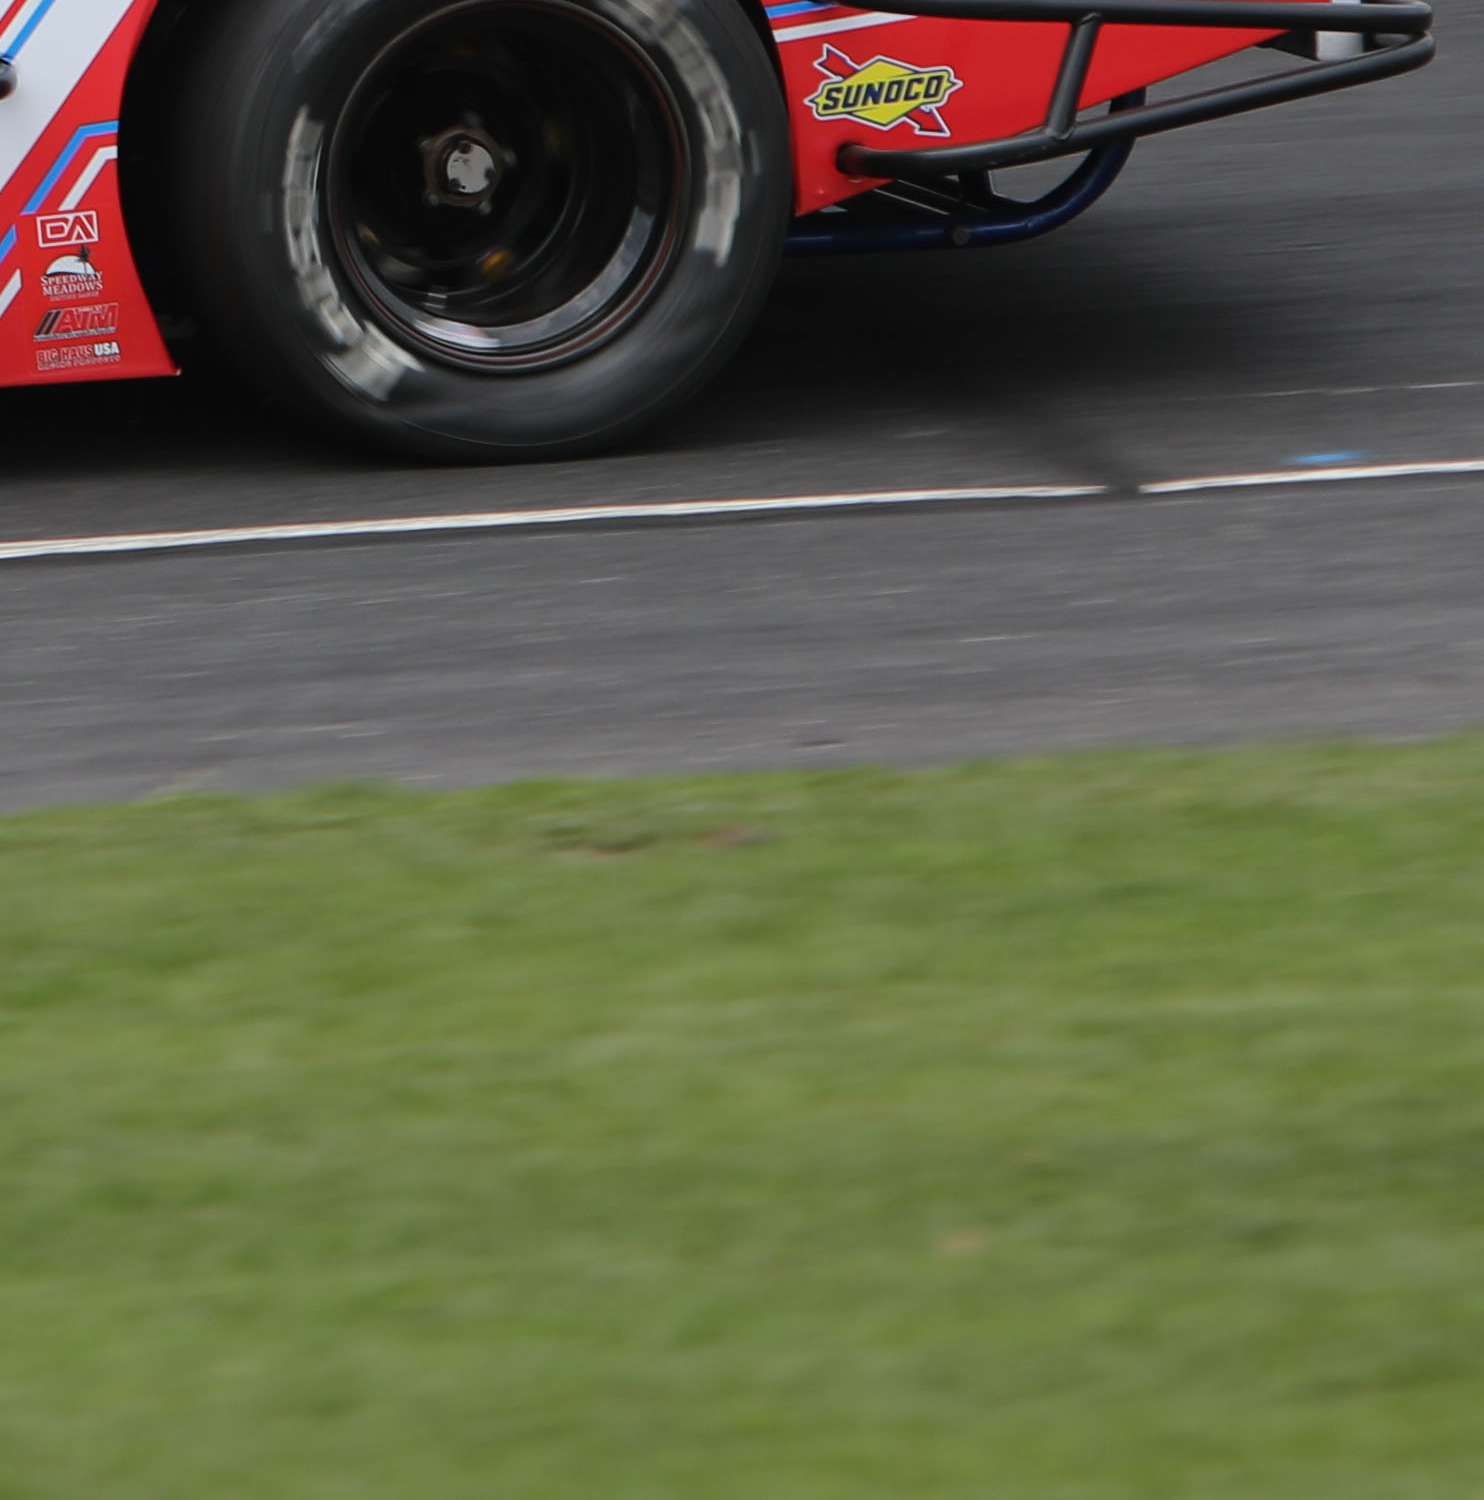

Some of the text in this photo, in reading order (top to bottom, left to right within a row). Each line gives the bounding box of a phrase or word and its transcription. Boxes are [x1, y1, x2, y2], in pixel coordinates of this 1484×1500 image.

[822, 74, 943, 111] SUNOCO
[41, 271, 103, 286] SPEEDWAY
[43, 280, 103, 296] MEADOWS
[94, 341, 120, 356] USA
